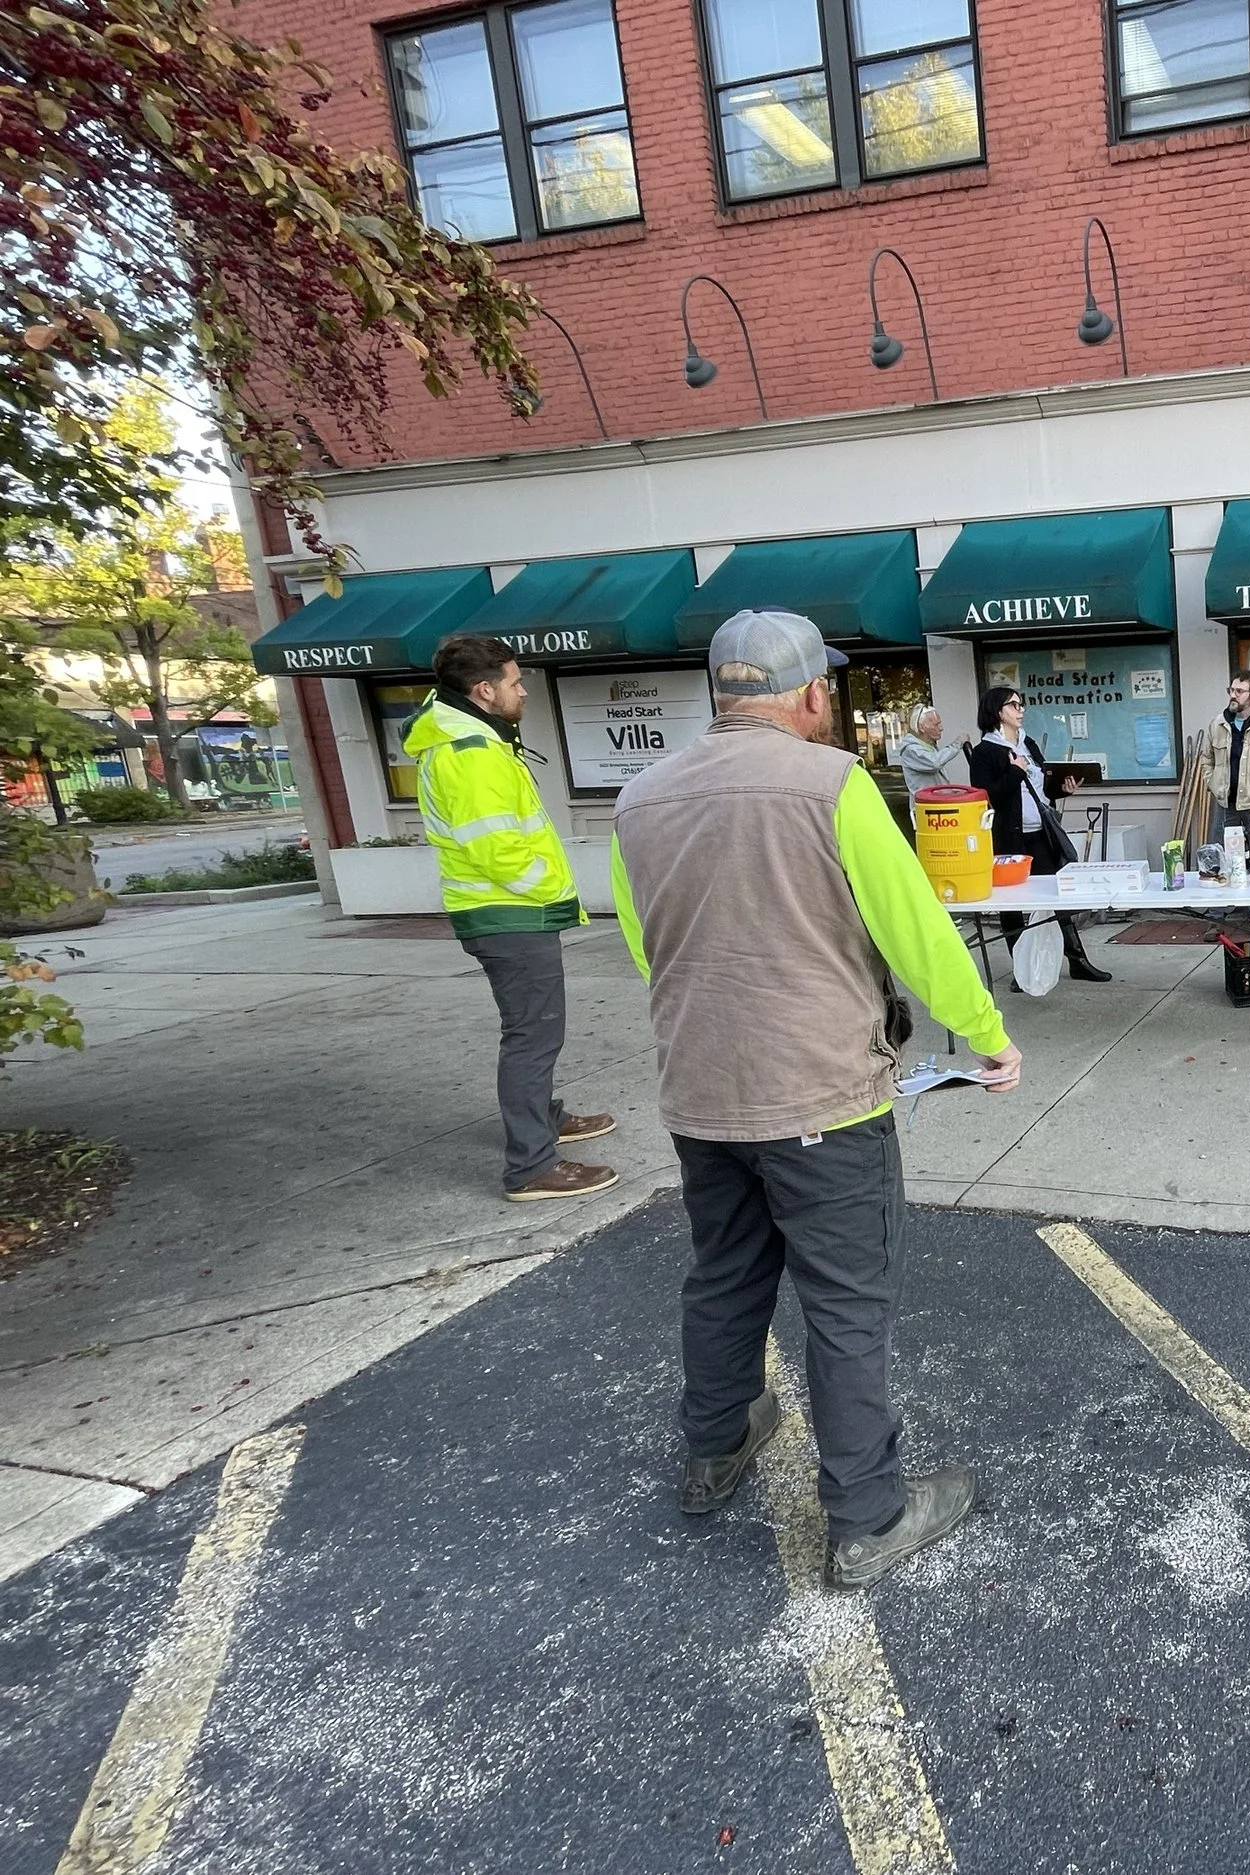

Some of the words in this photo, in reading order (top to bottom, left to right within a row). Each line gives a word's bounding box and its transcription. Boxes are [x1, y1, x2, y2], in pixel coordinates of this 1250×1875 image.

[963, 594, 1092, 626] ACHIEVE
[493, 629, 592, 655] XPLORE
[282, 645, 374, 669] RESPECT
[619, 680, 639, 690] step
[1027, 672, 1064, 688] Head
[1072, 671, 1115, 687] Start
[620, 687, 658, 698] forward
[606, 706, 633, 719] Head
[635, 706, 663, 718] Start
[606, 723, 665, 750] Villa
[926, 812, 959, 831] igloo
